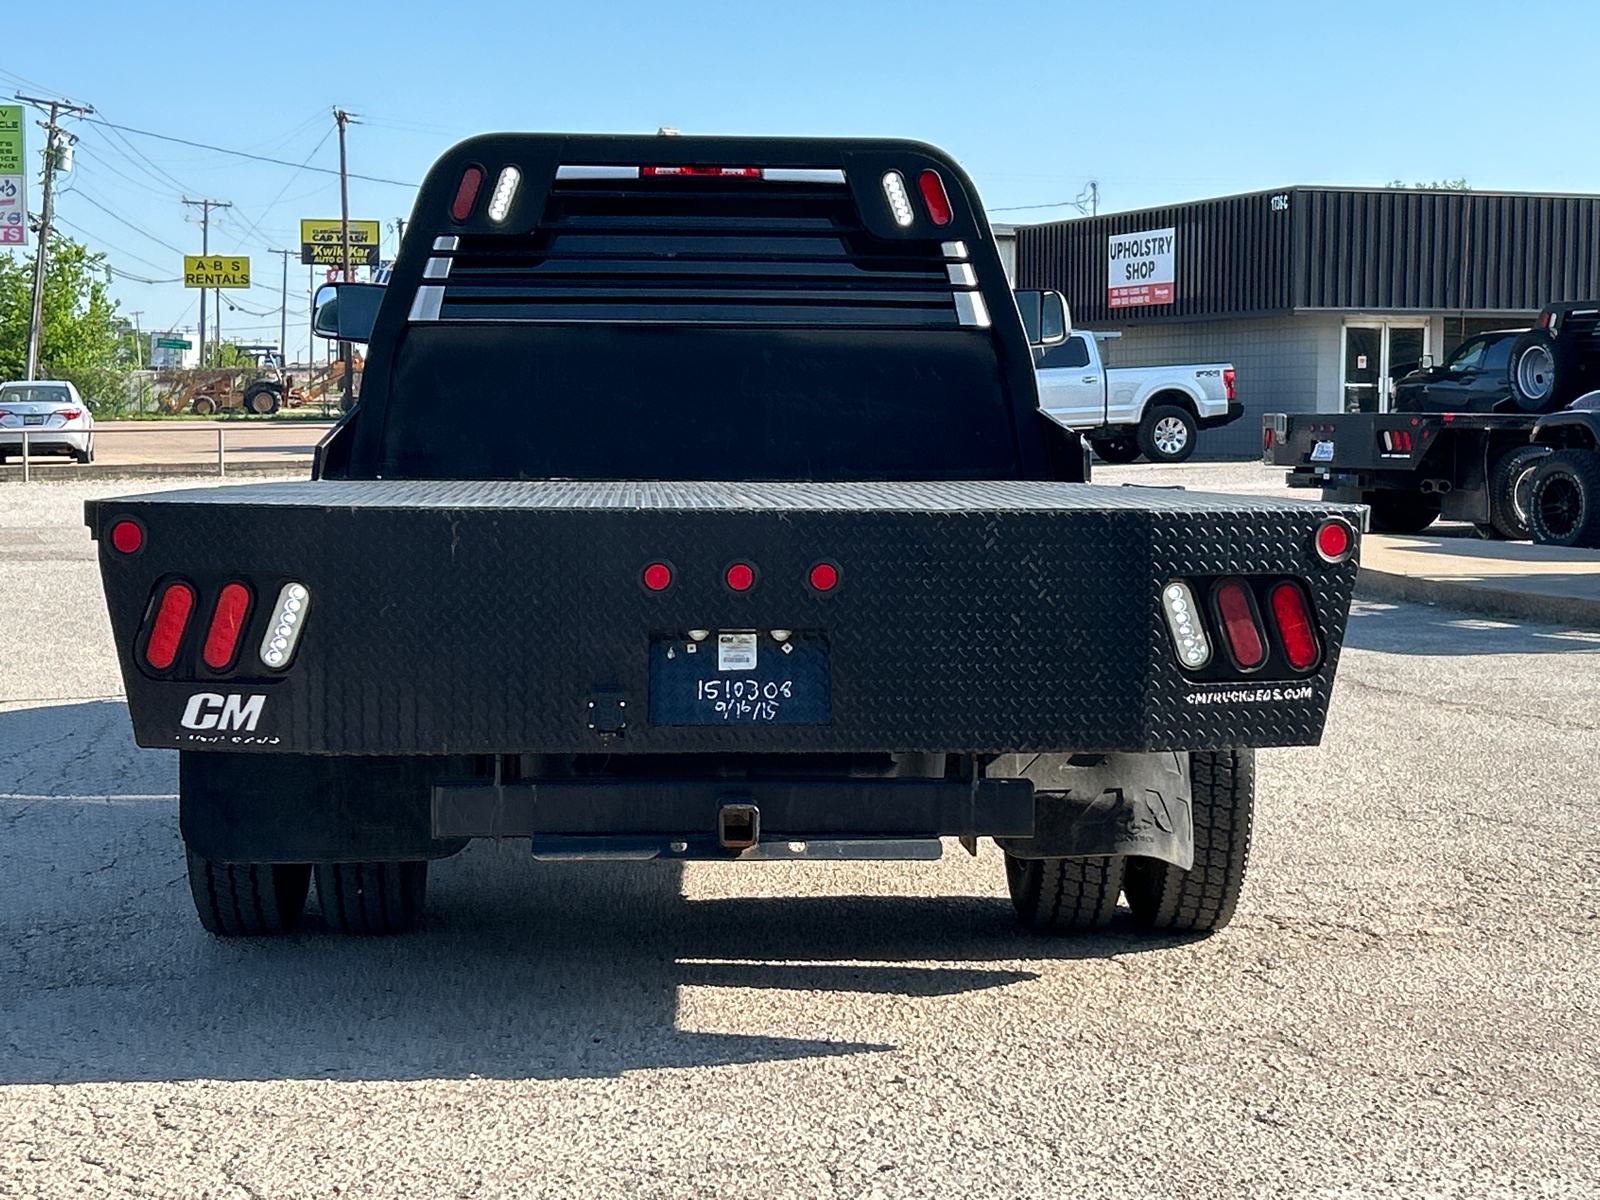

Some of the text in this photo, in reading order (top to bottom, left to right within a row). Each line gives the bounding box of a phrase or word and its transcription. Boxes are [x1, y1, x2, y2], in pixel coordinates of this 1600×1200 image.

[312, 234, 334, 242] CAR
[312, 245, 371, 257] Kwik Kar
[1109, 235, 1173, 260] UPHOLSTRY
[336, 256, 367, 264] CNTER
[186, 273, 249, 284] RENTALS
[1125, 260, 1155, 281] SHOP
[180, 692, 267, 731] CM
[714, 699, 780, 720] 9/16/15
